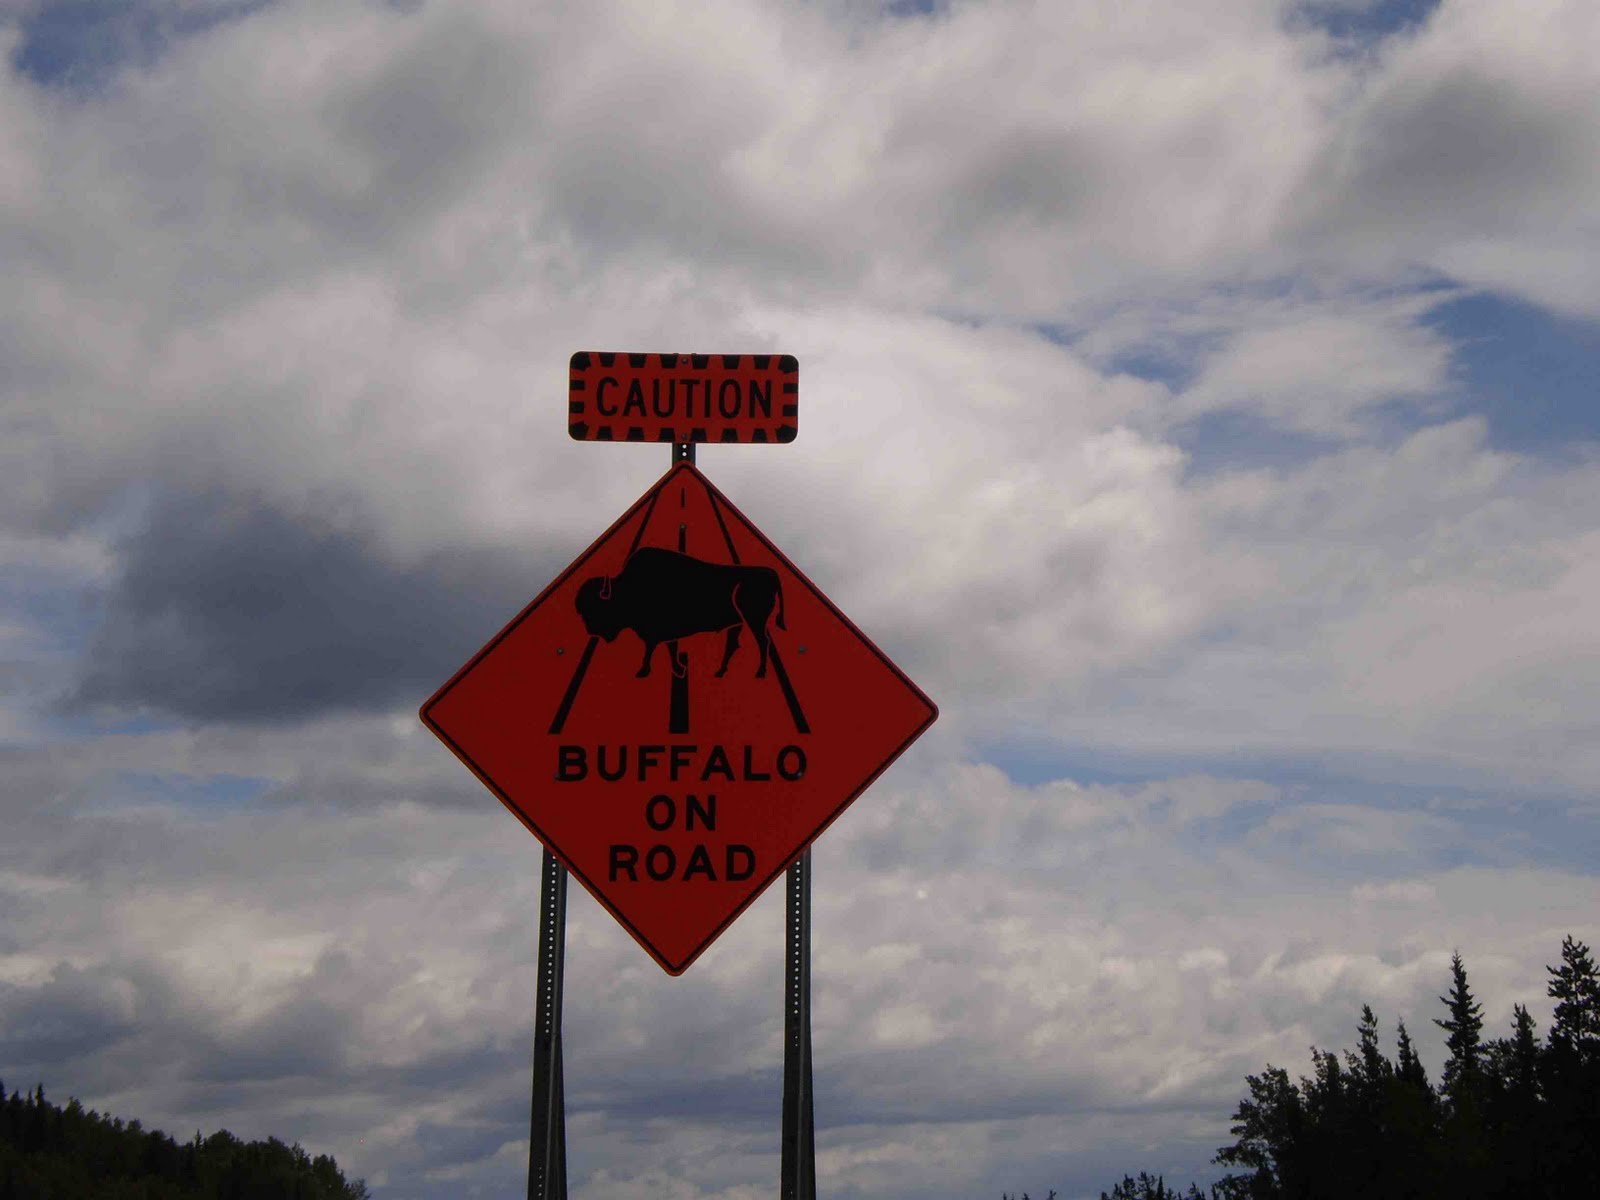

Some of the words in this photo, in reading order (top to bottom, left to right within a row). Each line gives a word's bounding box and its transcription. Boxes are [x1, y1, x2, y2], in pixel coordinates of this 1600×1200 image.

[596, 376, 772, 419] CAUTION
[557, 744, 808, 783] BUFFALO
[645, 794, 717, 832] ON
[608, 844, 756, 883] ROAD
